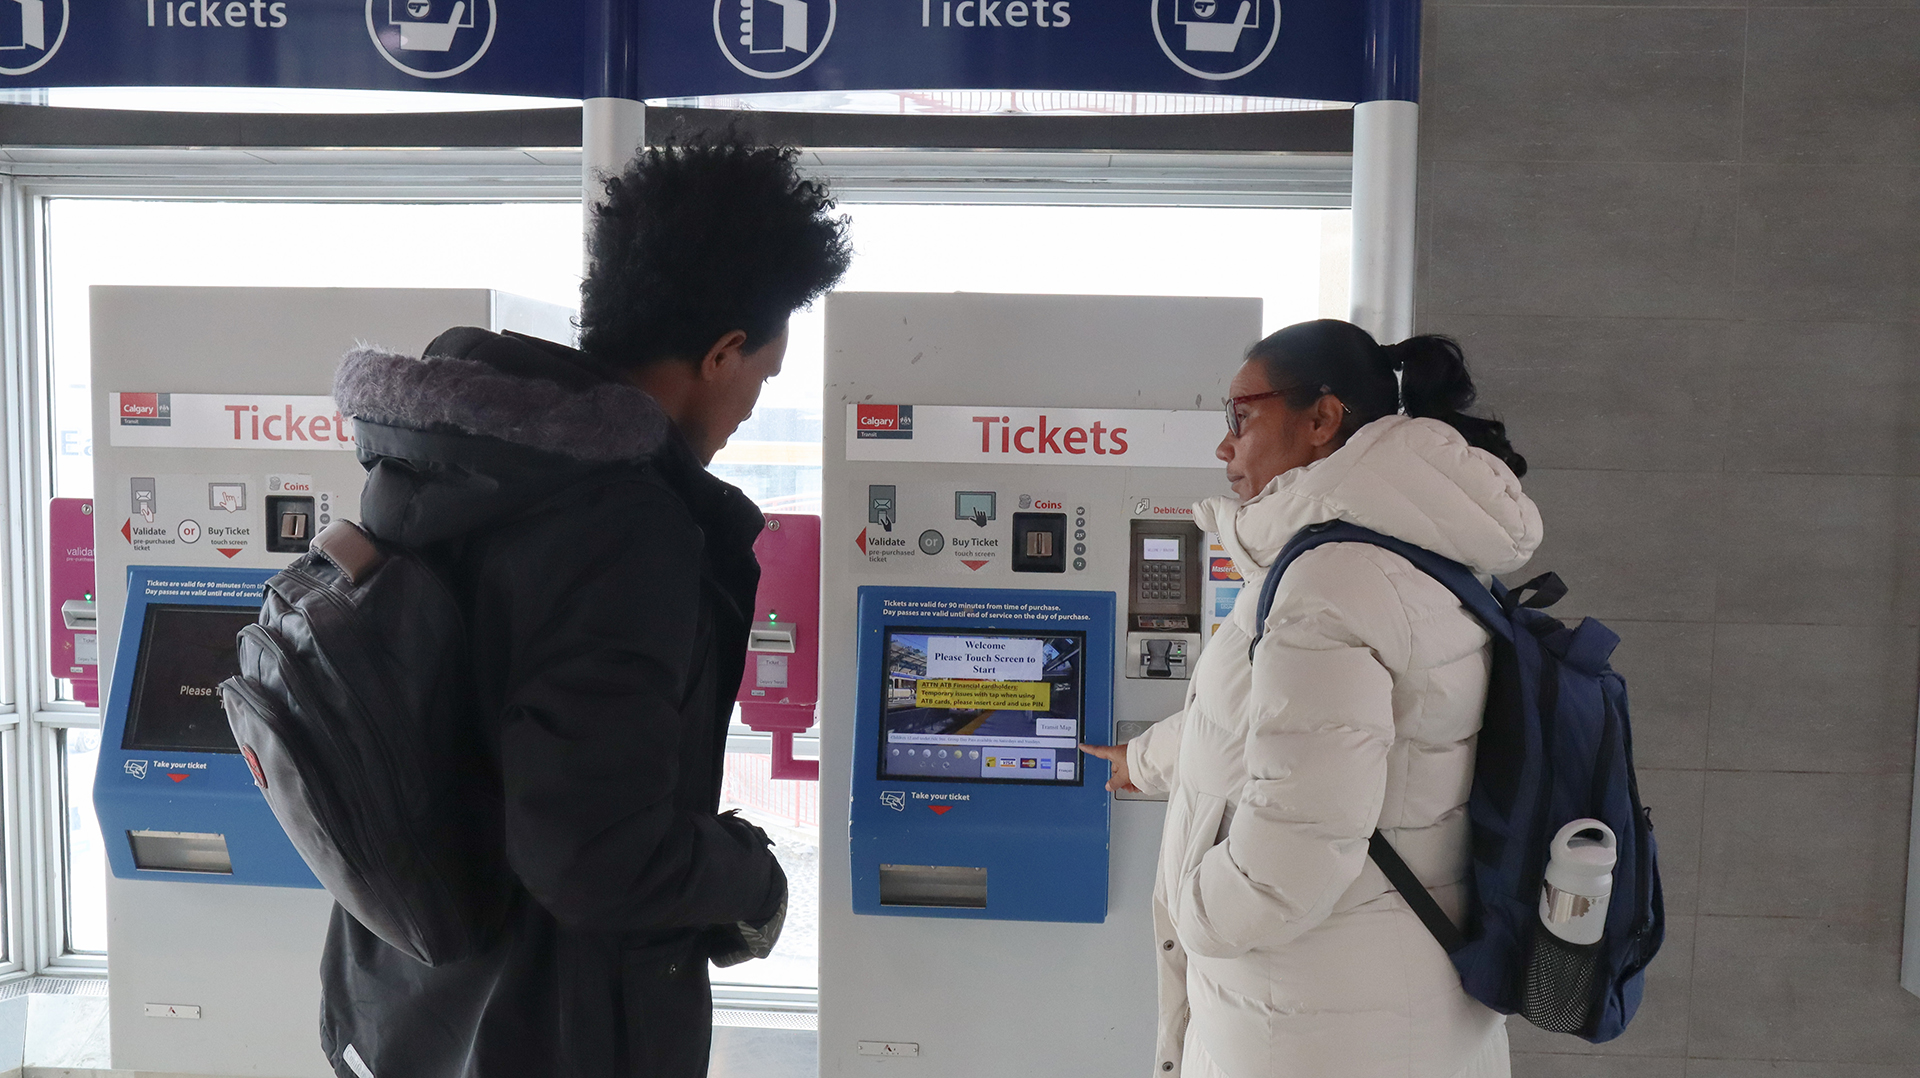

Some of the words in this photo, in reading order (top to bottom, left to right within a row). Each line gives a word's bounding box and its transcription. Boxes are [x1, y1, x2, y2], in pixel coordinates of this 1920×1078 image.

[147, 0, 287, 27] Tickets
[922, 0, 1071, 27] Tickets
[124, 404, 154, 414] Calgary
[225, 404, 355, 442] Ticket
[861, 416, 894, 427] Calgary
[972, 415, 1128, 455] Tickets
[284, 482, 309, 490] Coins
[1035, 500, 1062, 509] Coins
[133, 527, 166, 535] Validate
[208, 527, 224, 536] Buy
[225, 527, 250, 535] Ticket
[869, 538, 905, 546] Validate
[925, 538, 938, 546] or
[952, 538, 970, 548] Buy
[971, 538, 998, 546] Ticket
[145, 588, 157, 596] Day
[1036, 613, 1048, 621] day
[965, 641, 1006, 650] Welcome
[934, 652, 962, 661] Please
[965, 653, 992, 662] Touch
[994, 654, 1024, 663] Screen
[1027, 655, 1036, 663] to
[973, 665, 996, 674] Start
[180, 685, 212, 696] Please
[153, 760, 170, 768] Take
[170, 762, 187, 770] your
